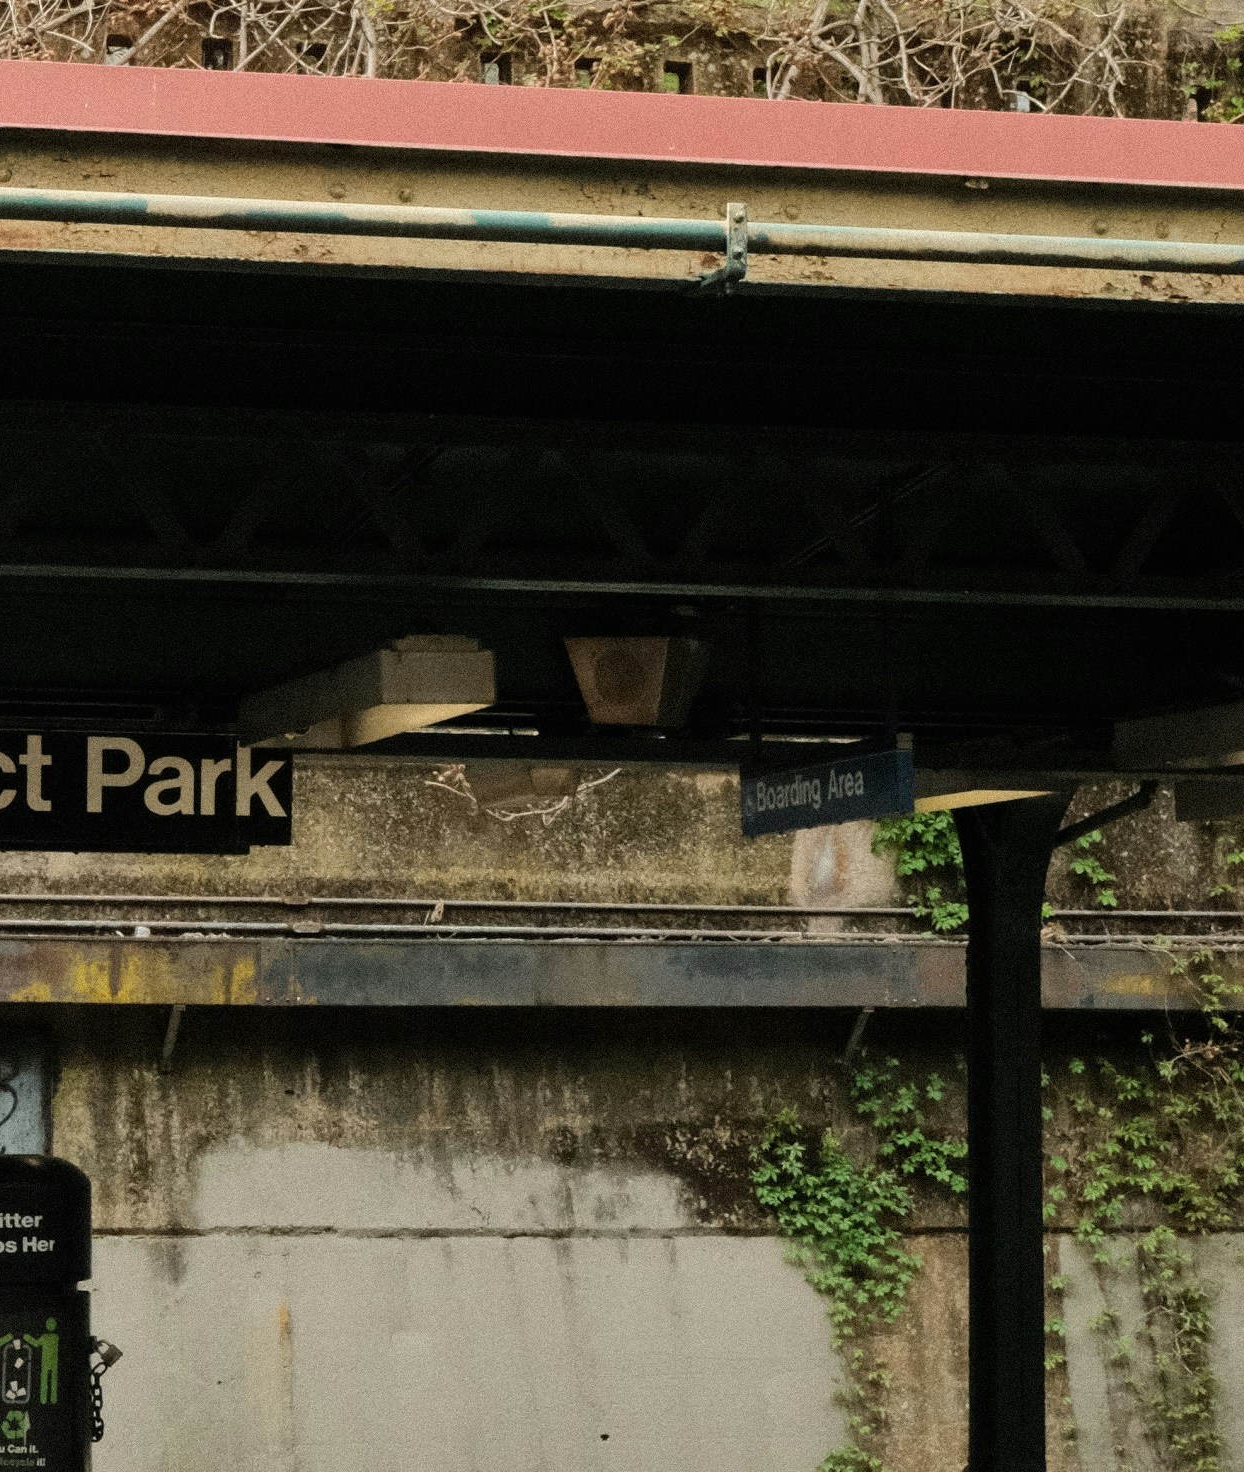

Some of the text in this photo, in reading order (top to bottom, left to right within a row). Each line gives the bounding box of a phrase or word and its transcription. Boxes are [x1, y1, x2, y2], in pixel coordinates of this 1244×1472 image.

[86, 737, 287, 817] Park
[756, 769, 865, 810] Boarding Area
[7, 1443, 27, 1454] Can
